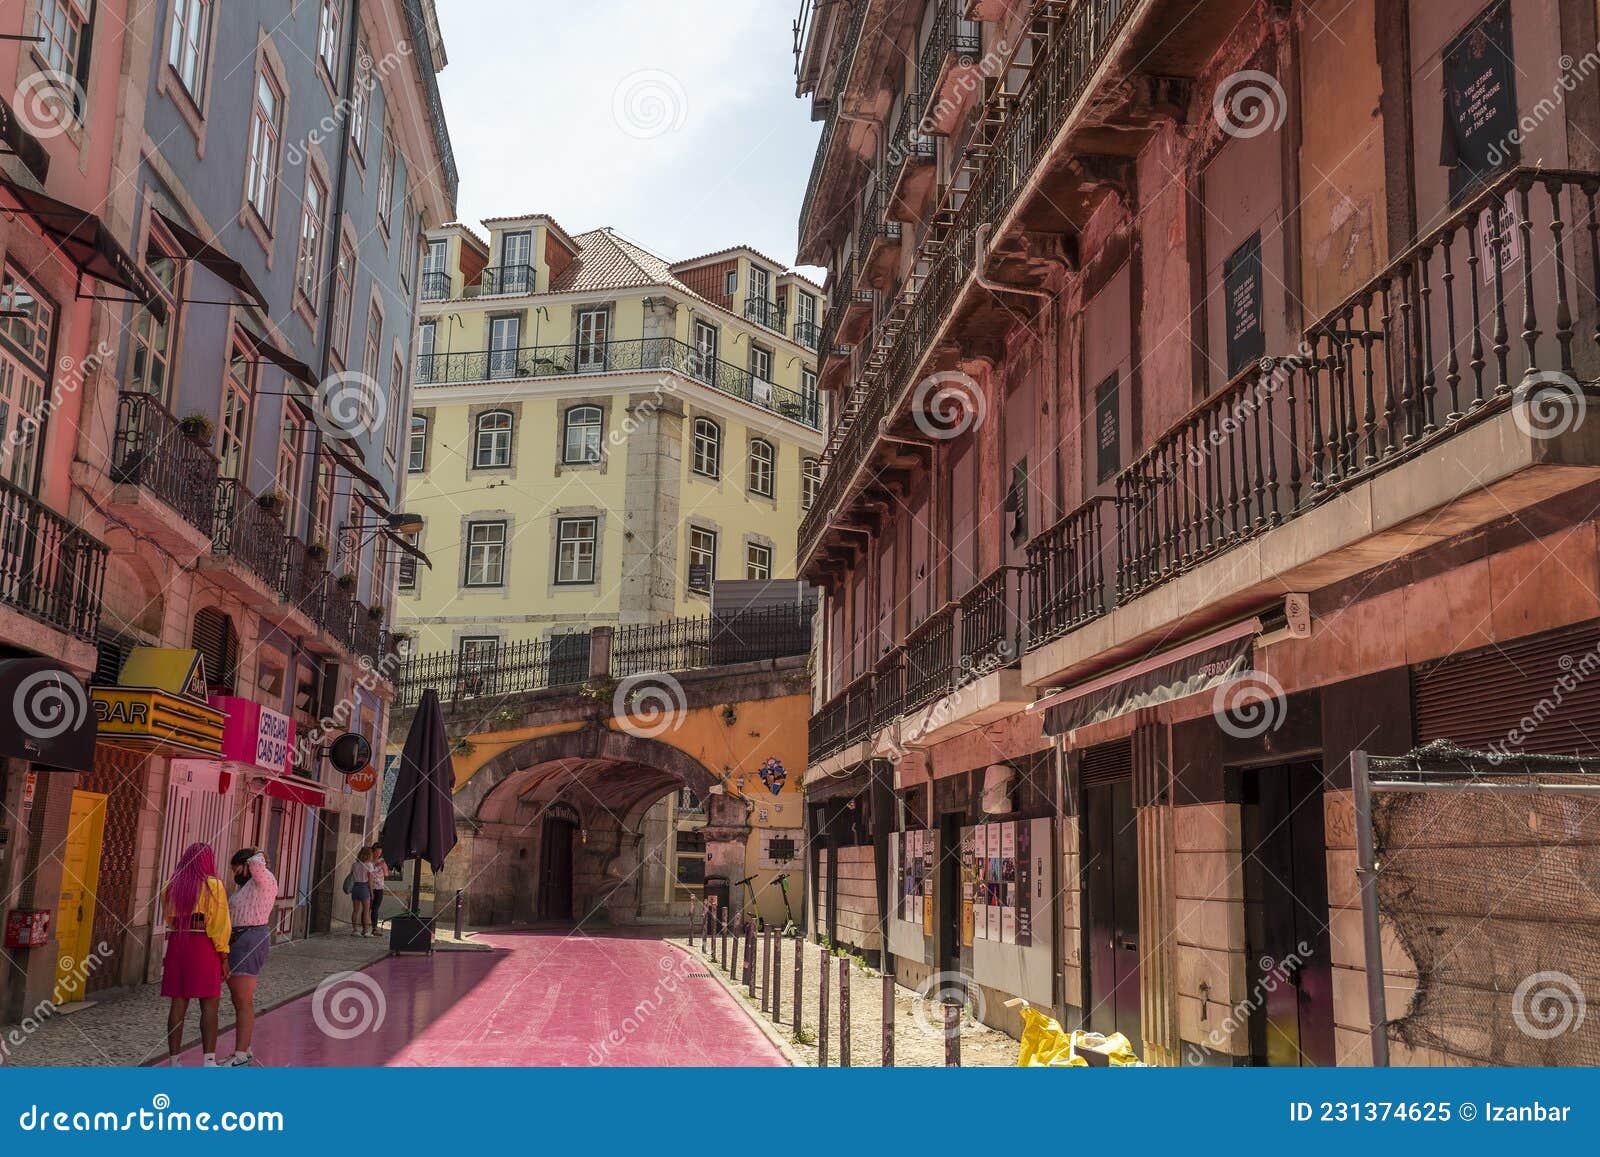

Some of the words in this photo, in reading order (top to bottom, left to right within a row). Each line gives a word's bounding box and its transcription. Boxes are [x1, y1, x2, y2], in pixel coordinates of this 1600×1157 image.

[1464, 84, 1476, 97] YOU
[1476, 67, 1493, 88] STARE
[1471, 84, 1486, 102] MORE
[1459, 111, 1467, 123] AT
[1467, 99, 1482, 115] YOUR
[1482, 82, 1501, 102] PHONE
[1473, 103, 1488, 121] THAN
[1465, 127, 1473, 138] AT
[1473, 117, 1484, 130] THE
[1485, 107, 1497, 121] SEA
[192, 678, 205, 694] BAR
[92, 700, 149, 723] BAR
[257, 738, 274, 763] CAIS
[273, 743, 287, 766] BAR
[350, 772, 374, 783] ATM
